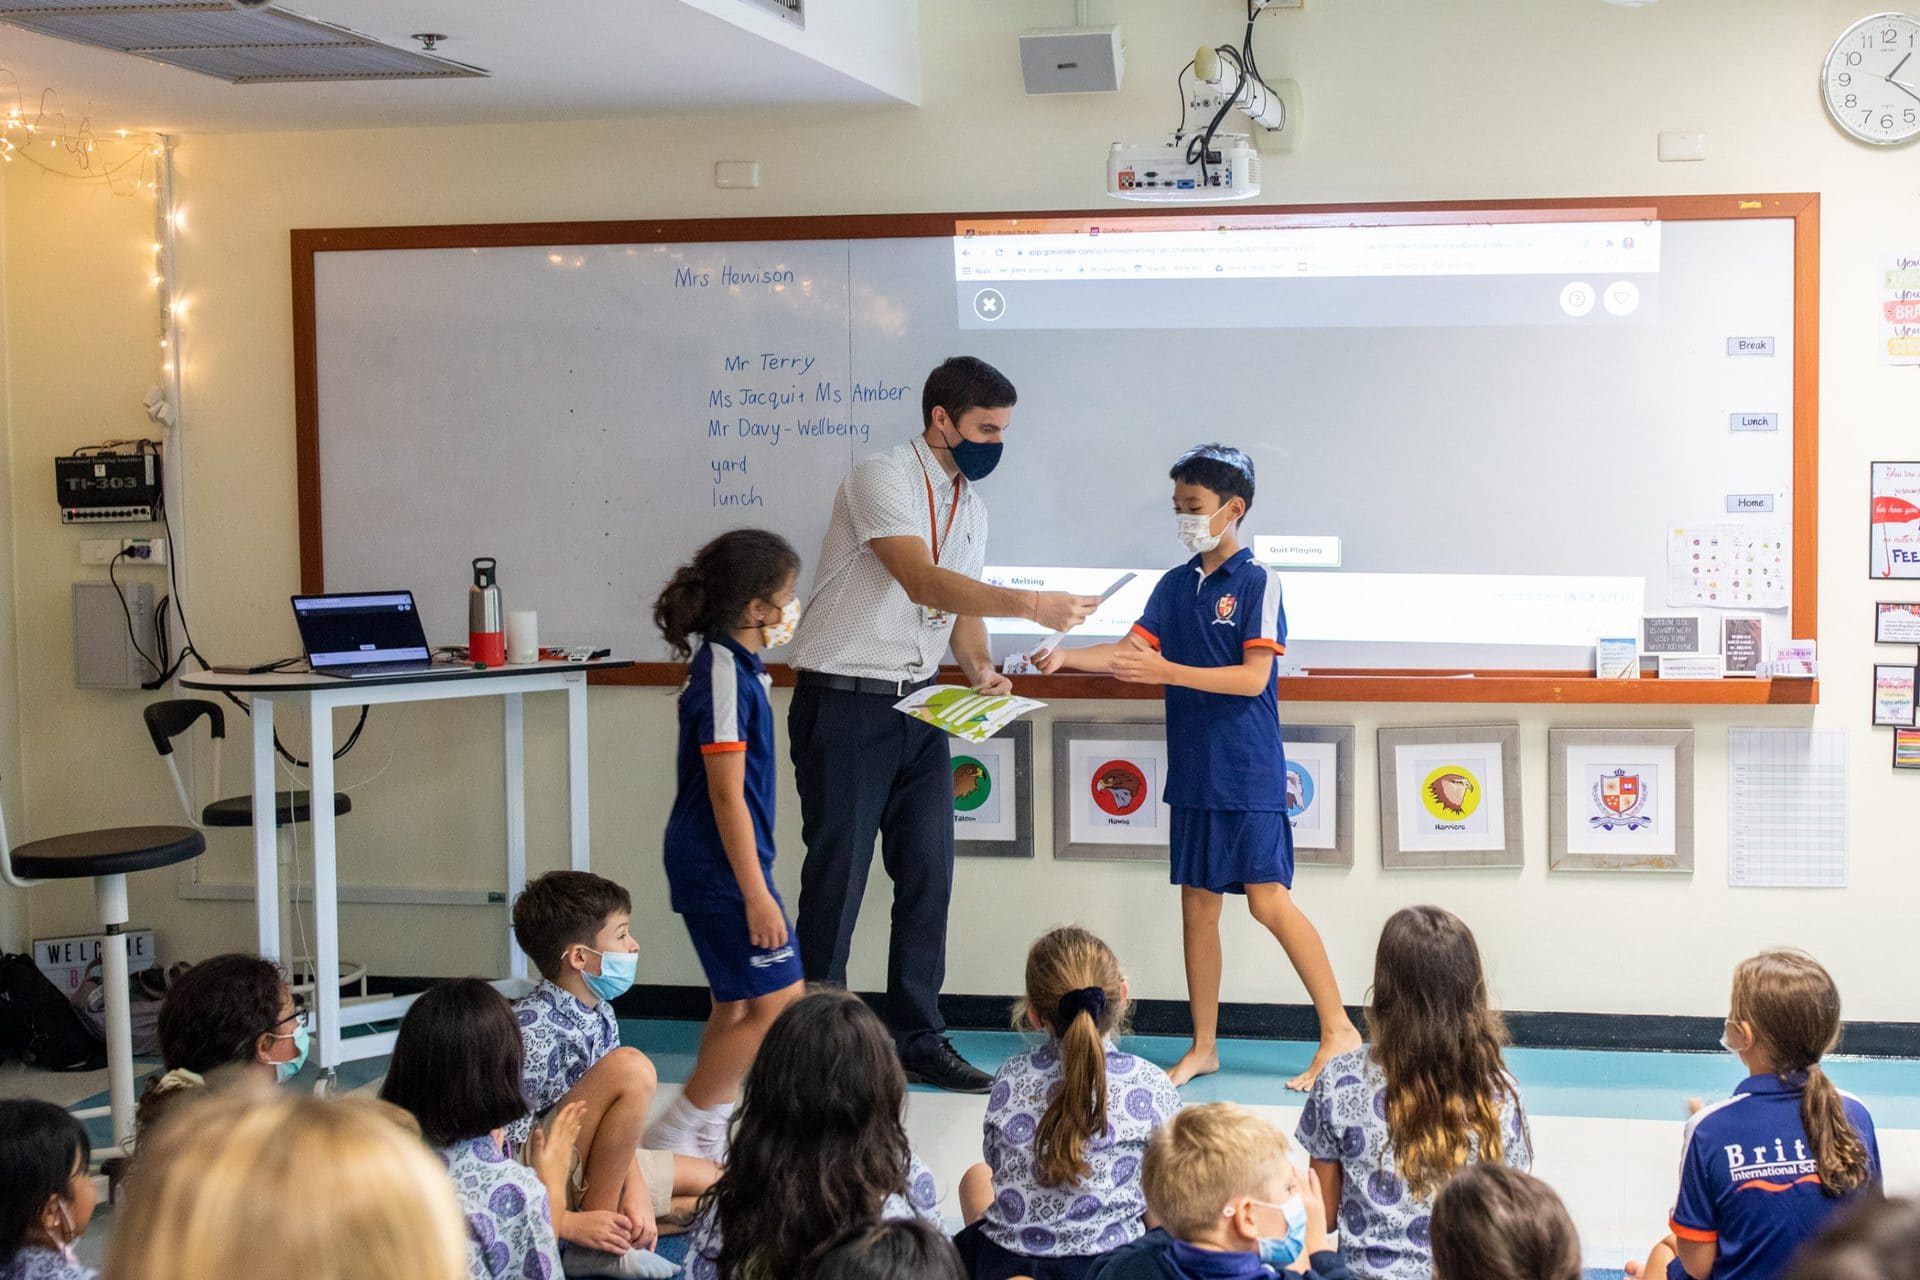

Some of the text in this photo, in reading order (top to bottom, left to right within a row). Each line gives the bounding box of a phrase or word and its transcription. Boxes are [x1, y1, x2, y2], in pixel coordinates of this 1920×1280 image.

[1862, 34, 1873, 49] 11
[1880, 29, 1897, 44] 12
[1908, 34, 1914, 48] 1
[1845, 51, 1862, 66] 10
[1838, 73, 1851, 87] 9
[1845, 94, 1857, 108] 8
[1861, 109, 1873, 124] 7
[1880, 114, 1893, 129] 6
[1903, 108, 1916, 123] 5
[674, 266, 794, 288] Mrs Hewison
[1738, 340, 1767, 350] Break
[725, 353, 816, 375] Mr Terry
[709, 390, 732, 408] Ms
[815, 382, 842, 402] Ms
[852, 380, 911, 402] Amber
[1741, 416, 1769, 426] Lunch
[708, 419, 729, 438] Mr
[797, 416, 870, 443] Wellbeing
[711, 456, 748, 484] yard
[713, 486, 763, 506] lunch
[1738, 498, 1764, 508] Home
[1290, 546, 1322, 555] Playing
[1011, 577, 1044, 587] Melting
[48, 936, 144, 964] WELCE
[1731, 1165, 1798, 1182] International
